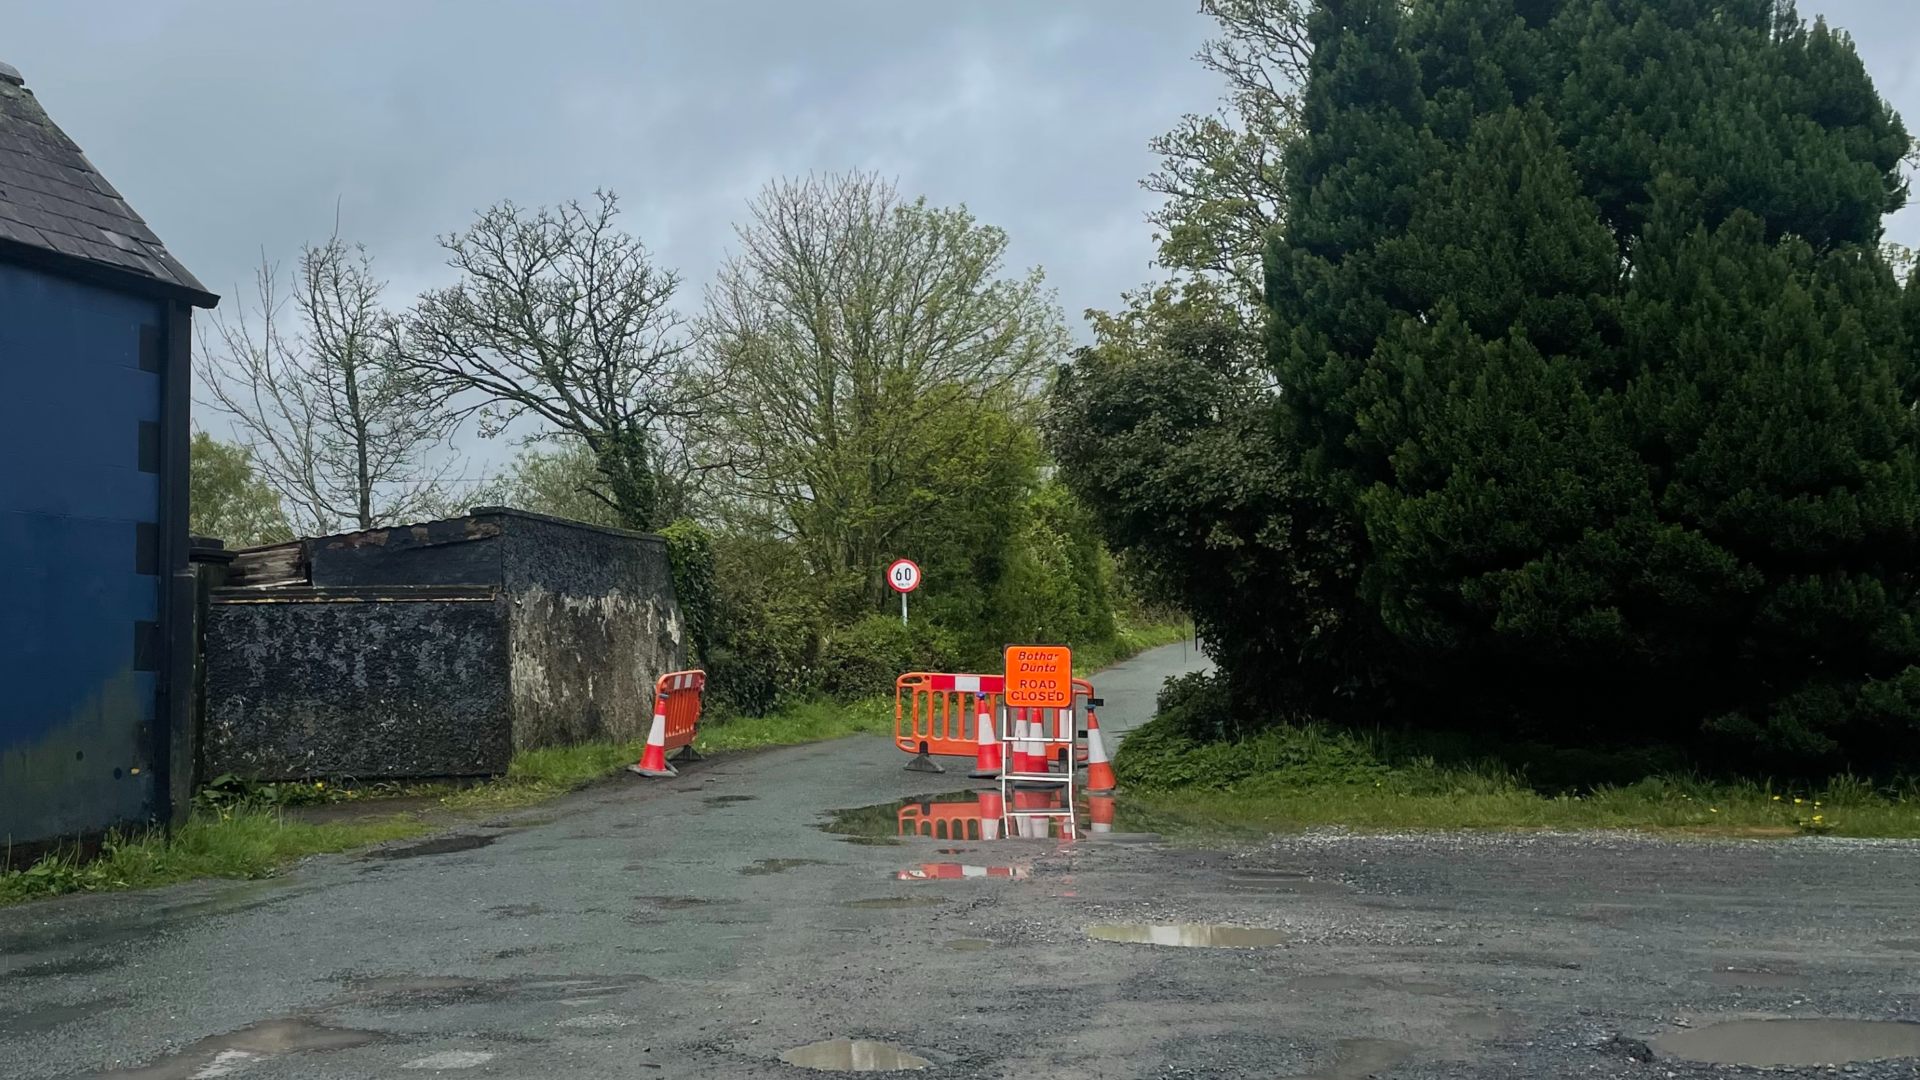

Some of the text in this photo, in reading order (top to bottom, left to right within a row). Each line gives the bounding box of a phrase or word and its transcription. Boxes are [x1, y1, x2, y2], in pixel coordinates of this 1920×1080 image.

[896, 567, 912, 581] 60
[1020, 679, 1057, 690] ROAD
[1011, 691, 1065, 702] CLOSED
